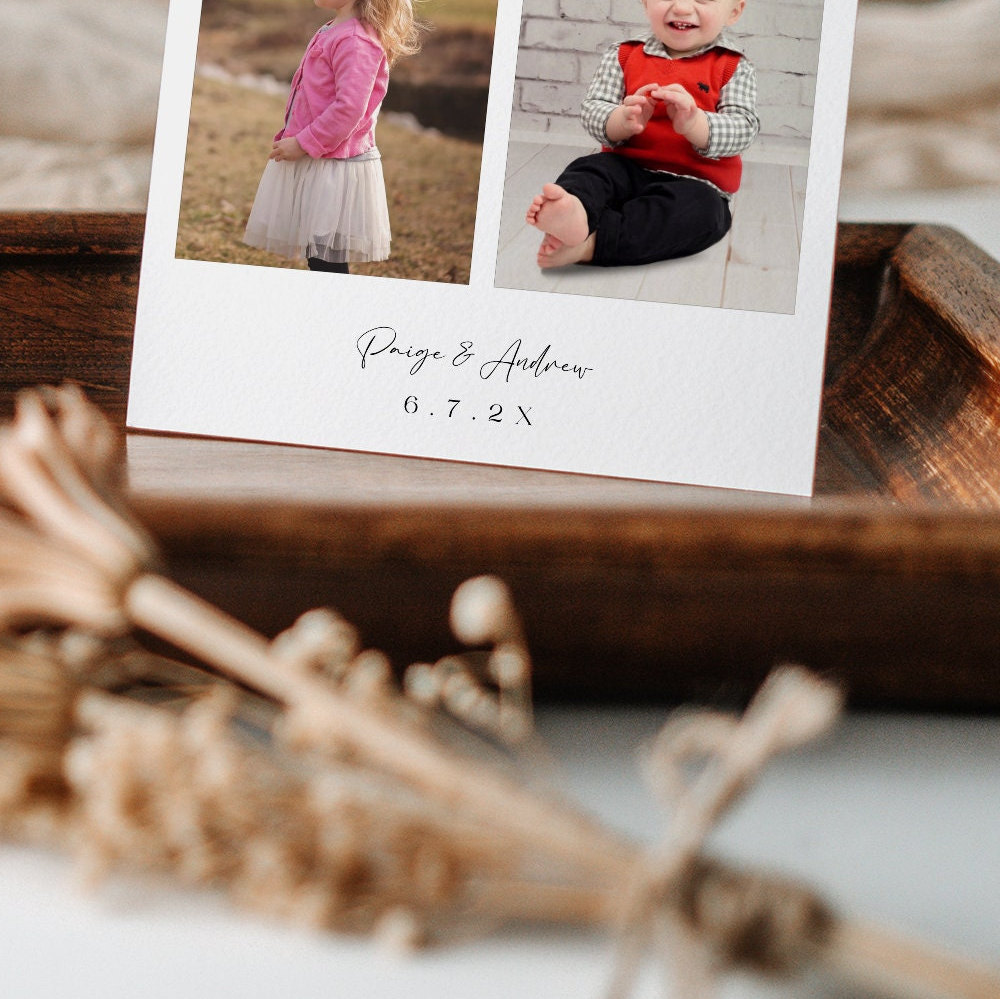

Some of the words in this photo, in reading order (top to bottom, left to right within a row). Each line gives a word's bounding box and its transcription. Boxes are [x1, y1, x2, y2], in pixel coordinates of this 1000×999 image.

[356, 326, 446, 376] Paige
[451, 341, 476, 367] &
[479, 338, 594, 383] Andrew
